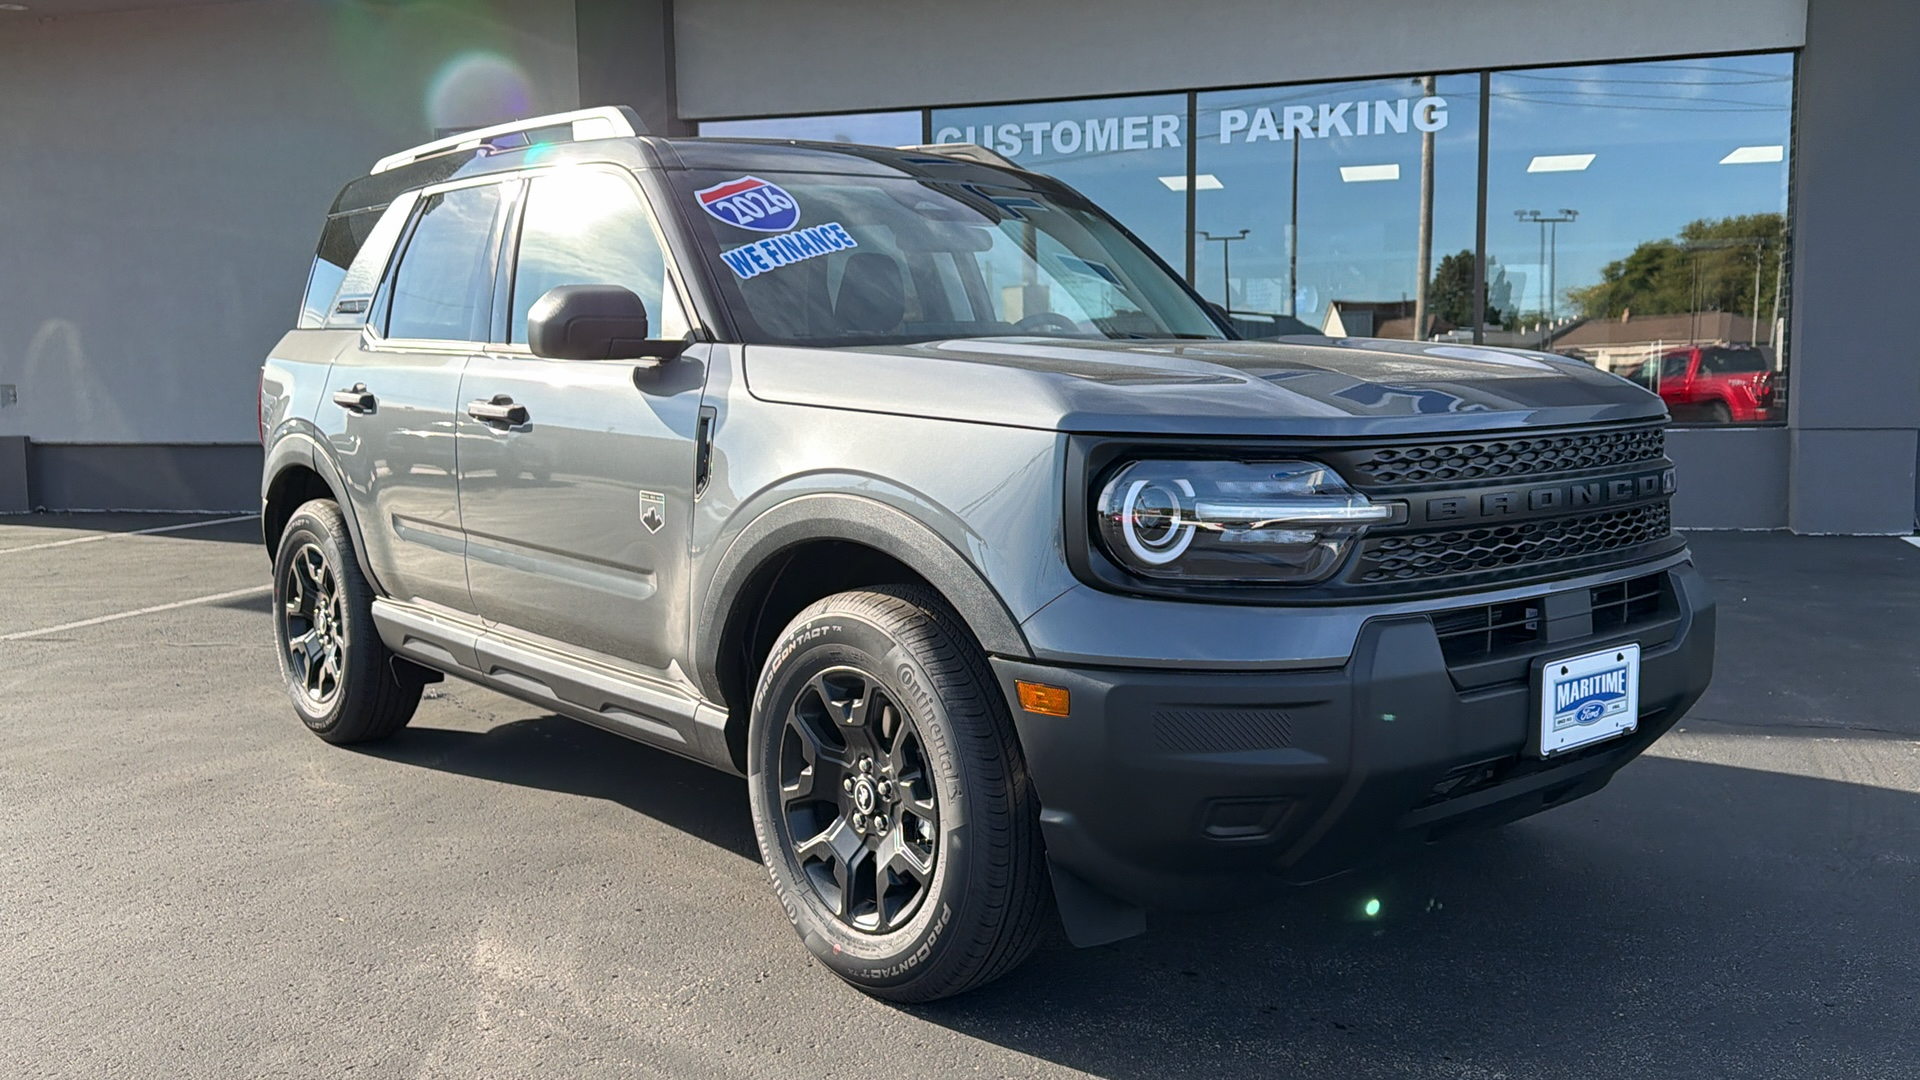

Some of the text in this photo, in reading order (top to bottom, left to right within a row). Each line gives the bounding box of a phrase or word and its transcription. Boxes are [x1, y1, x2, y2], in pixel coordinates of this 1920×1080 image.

[1219, 96, 1449, 144] PARKING
[716, 187, 793, 225] 2026
[722, 224, 855, 278] WE FINANCE
[1426, 475, 1659, 522] BRONCO
[1557, 669, 1626, 712] MARITIME
[1580, 705, 1601, 721] Ford
[896, 663, 960, 784] Continental
